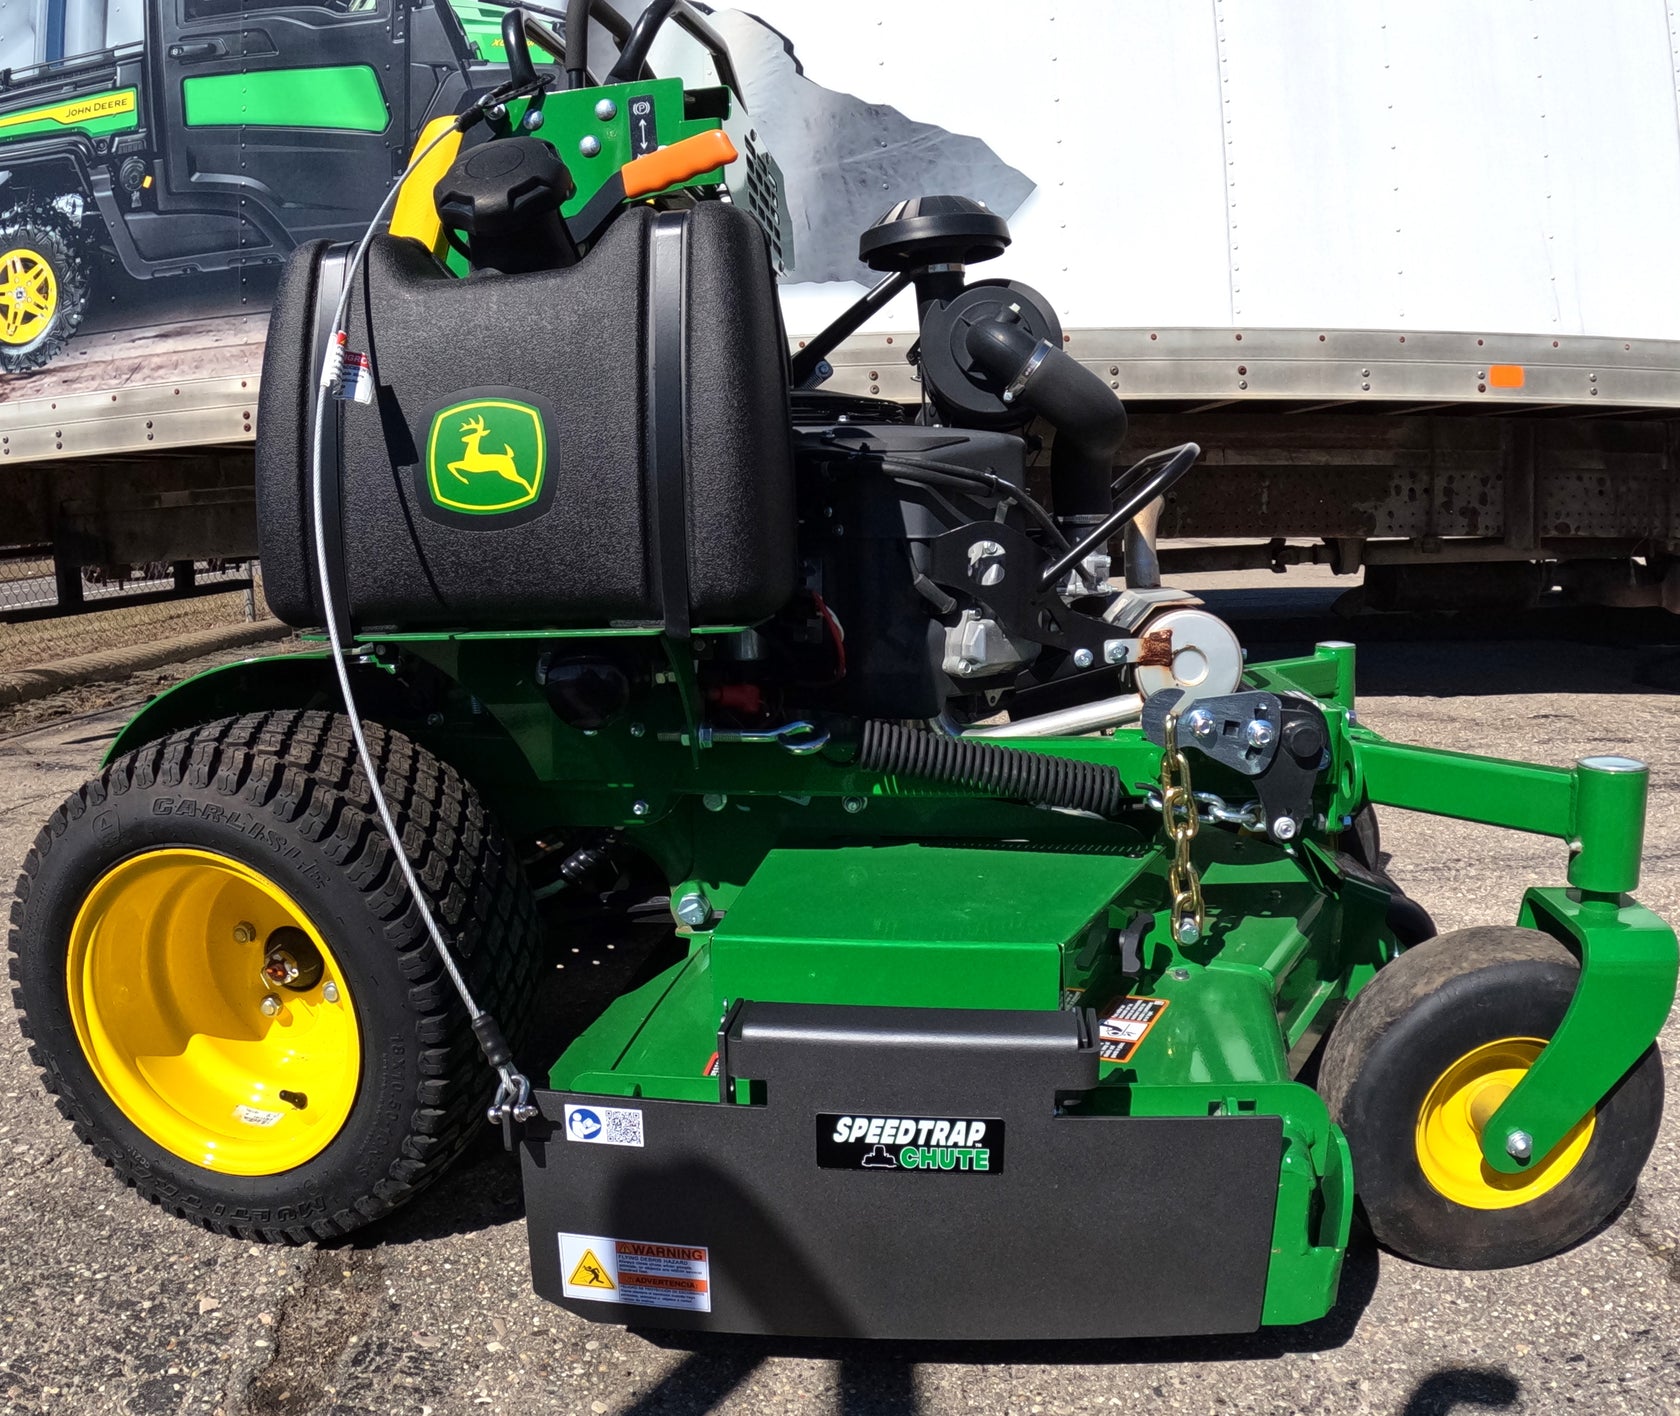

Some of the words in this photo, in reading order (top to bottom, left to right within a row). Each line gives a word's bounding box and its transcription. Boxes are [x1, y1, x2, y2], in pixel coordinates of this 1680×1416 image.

[65, 106, 92, 118] JOHN
[93, 98, 128, 112] DEERE
[152, 797, 331, 889] CARLISLE
[832, 1116, 987, 1147] SPEEDTRAP
[899, 1146, 990, 1171] CHUTE
[632, 1244, 703, 1260] WARNING
